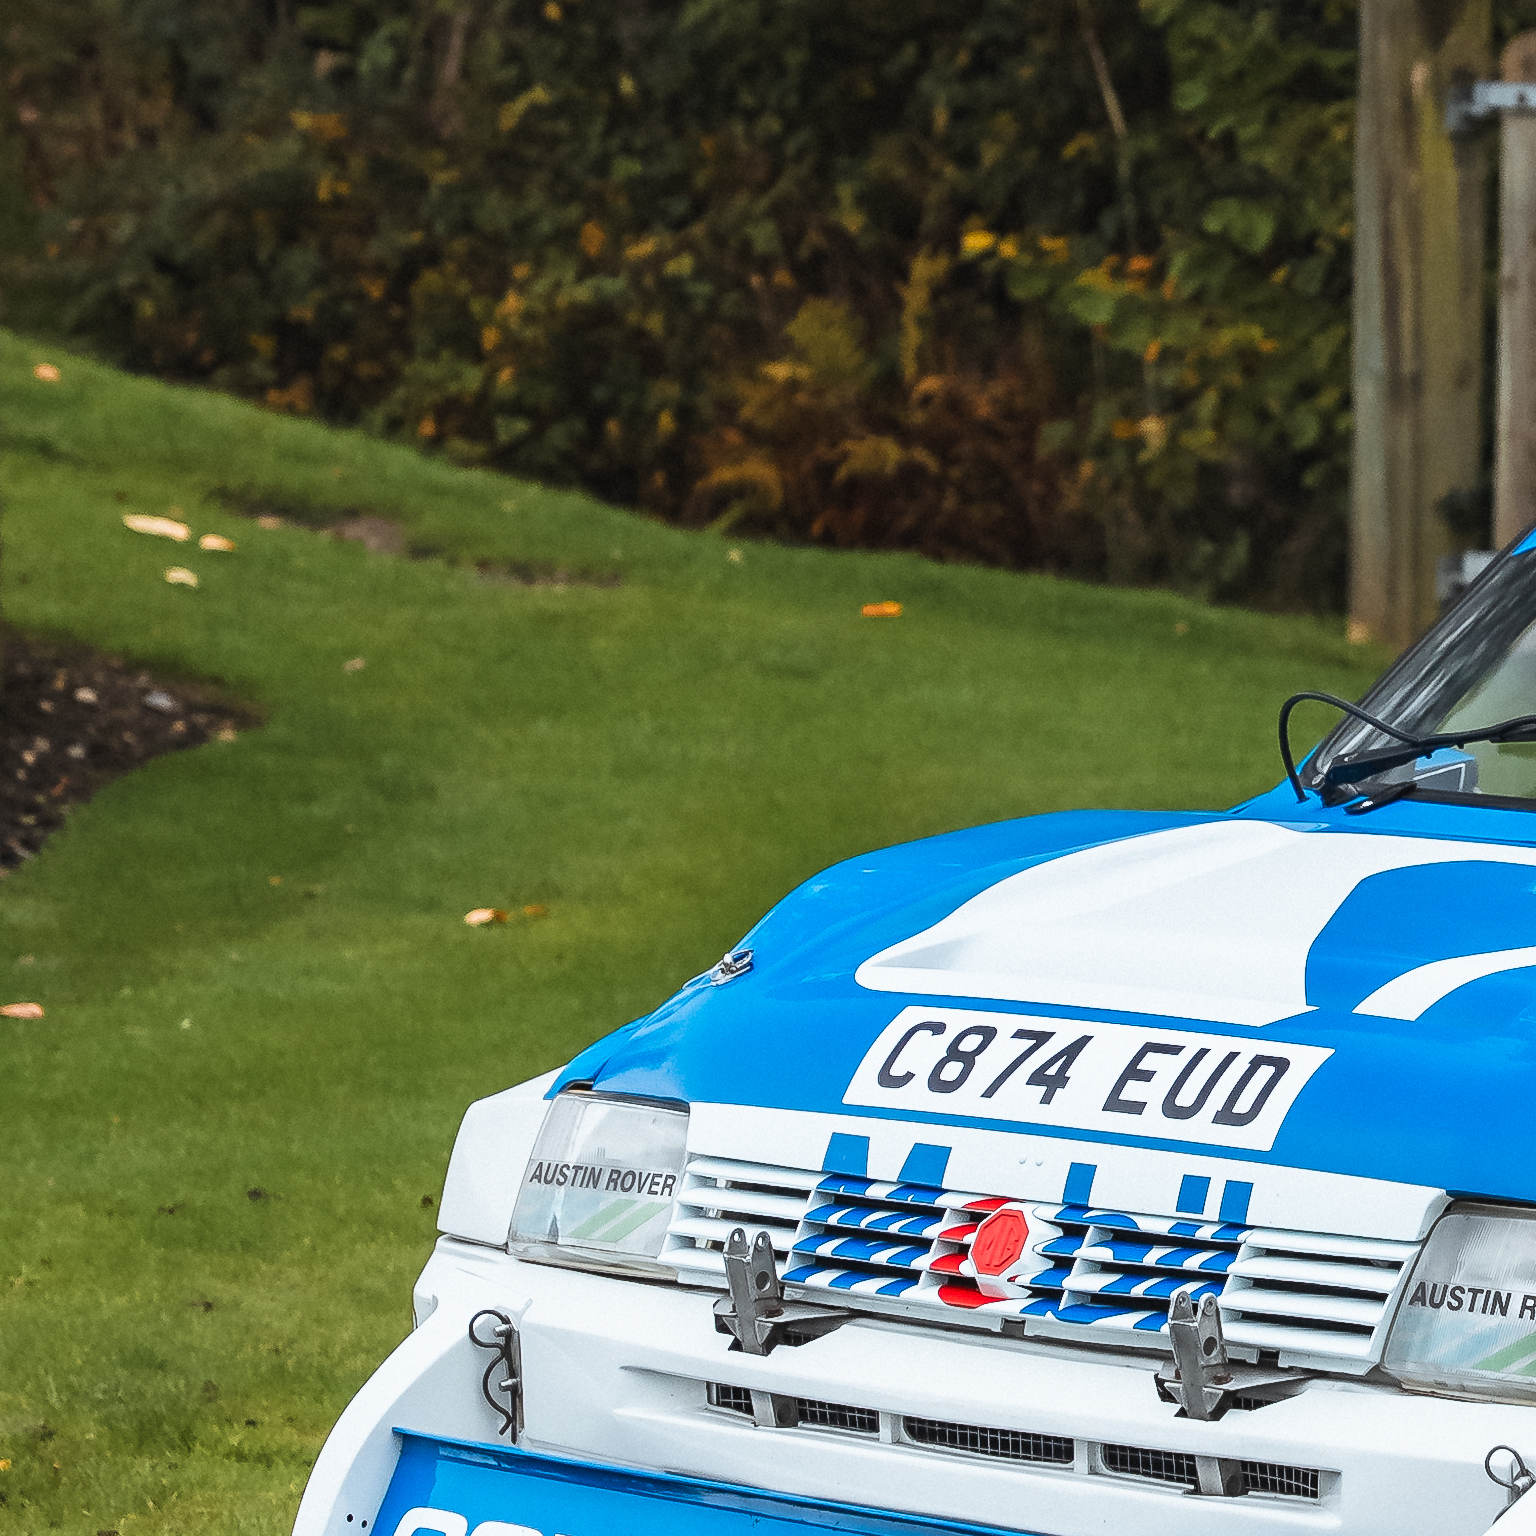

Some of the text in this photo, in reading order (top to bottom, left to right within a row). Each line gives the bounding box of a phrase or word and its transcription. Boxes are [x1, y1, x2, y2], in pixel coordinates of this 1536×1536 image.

[877, 1021, 1292, 1127] C874 EUD
[529, 1161, 677, 1196] AUSTIN ROVER
[1408, 1281, 1512, 1317] AUSTIN
